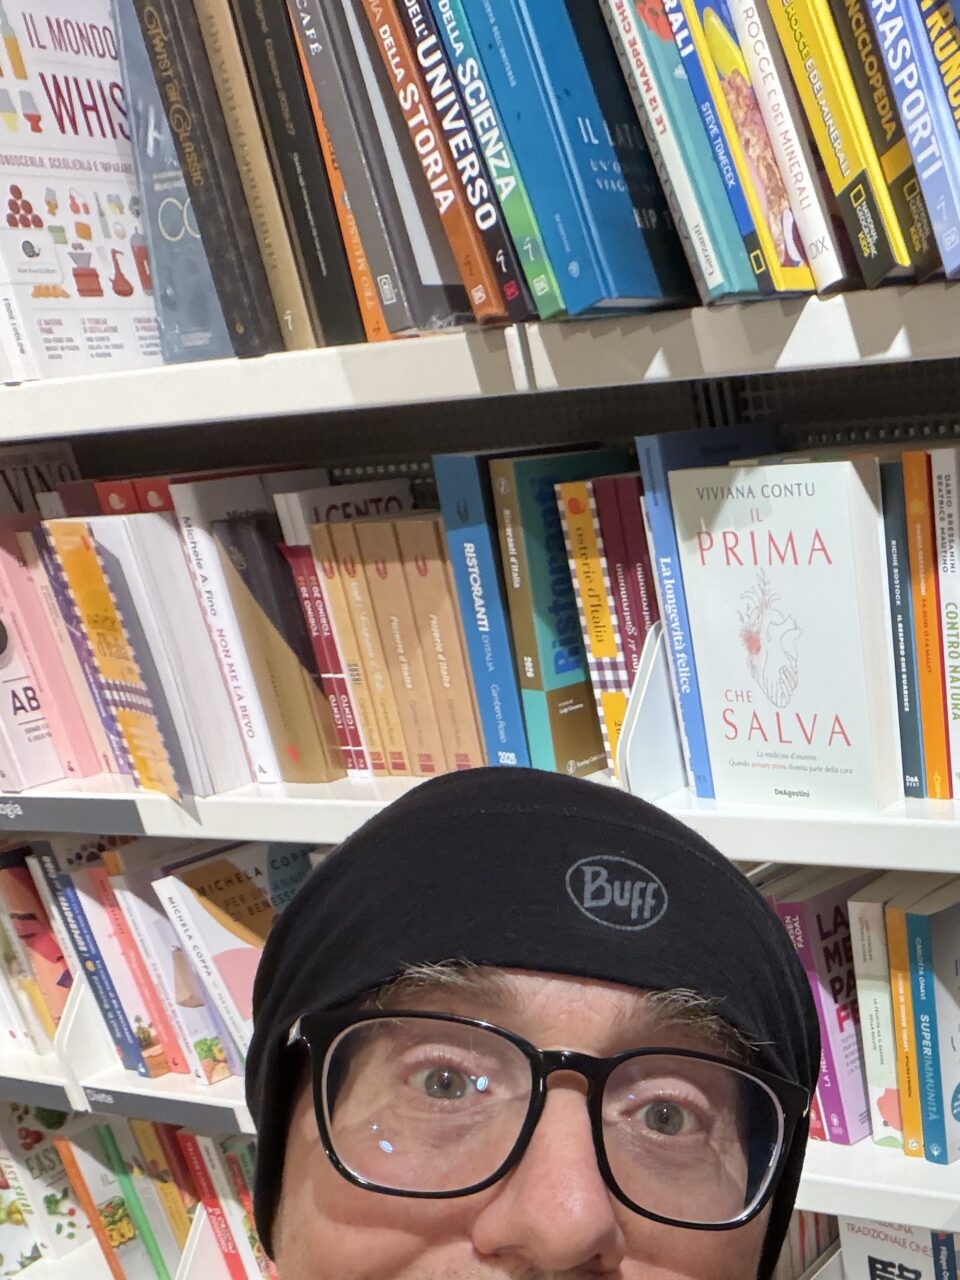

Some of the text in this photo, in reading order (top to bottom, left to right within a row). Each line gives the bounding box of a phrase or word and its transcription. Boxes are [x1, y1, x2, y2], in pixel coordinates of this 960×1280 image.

[22, 12, 118, 61] IL MONDO
[628, 36, 653, 94] MAPPE
[378, 24, 458, 216] DELLA STORIA
[437, 0, 466, 58] DELLA
[456, 54, 518, 203] SCIENZA
[647, 95, 660, 114] 12
[742, 7, 775, 86] ROCCE
[778, 130, 812, 212] MINERALI
[785, 5, 809, 60] ROCCE
[817, 98, 852, 178] MINERALI
[655, 114, 668, 136] LE
[700, 101, 738, 190] STEVE TOMECEK
[862, 201, 879, 243] NATIONAL
[696, 482, 817, 501] VIVIANA CONTU
[750, 508, 763, 524] IL
[936, 474, 946, 522] BEATRICE
[502, 508, 521, 589] Ristoranti d'Italia
[696, 528, 833, 567] PRIMA
[943, 474, 957, 573] DARIO BRESSANINI
[182, 515, 204, 571] Michele
[204, 589, 218, 618] Fino
[463, 541, 490, 633] RISTORANTI
[574, 526, 605, 643] osterie d'Italia
[659, 556, 691, 695] La longevità felice
[945, 602, 960, 659] CONTRO
[215, 627, 257, 740] NON ME LA BEVO
[725, 689, 753, 704] CHE
[722, 708, 852, 748] SALVA
[774, 788, 810, 799] DeAgostini
[579, 865, 658, 920] Buff
[166, 896, 213, 978] MICHELA COPPA
[792, 915, 805, 949] FADAL
[919, 1013, 939, 1122] SUPERIMMUNITÀ
[939, 1245, 949, 1271] Filippo
